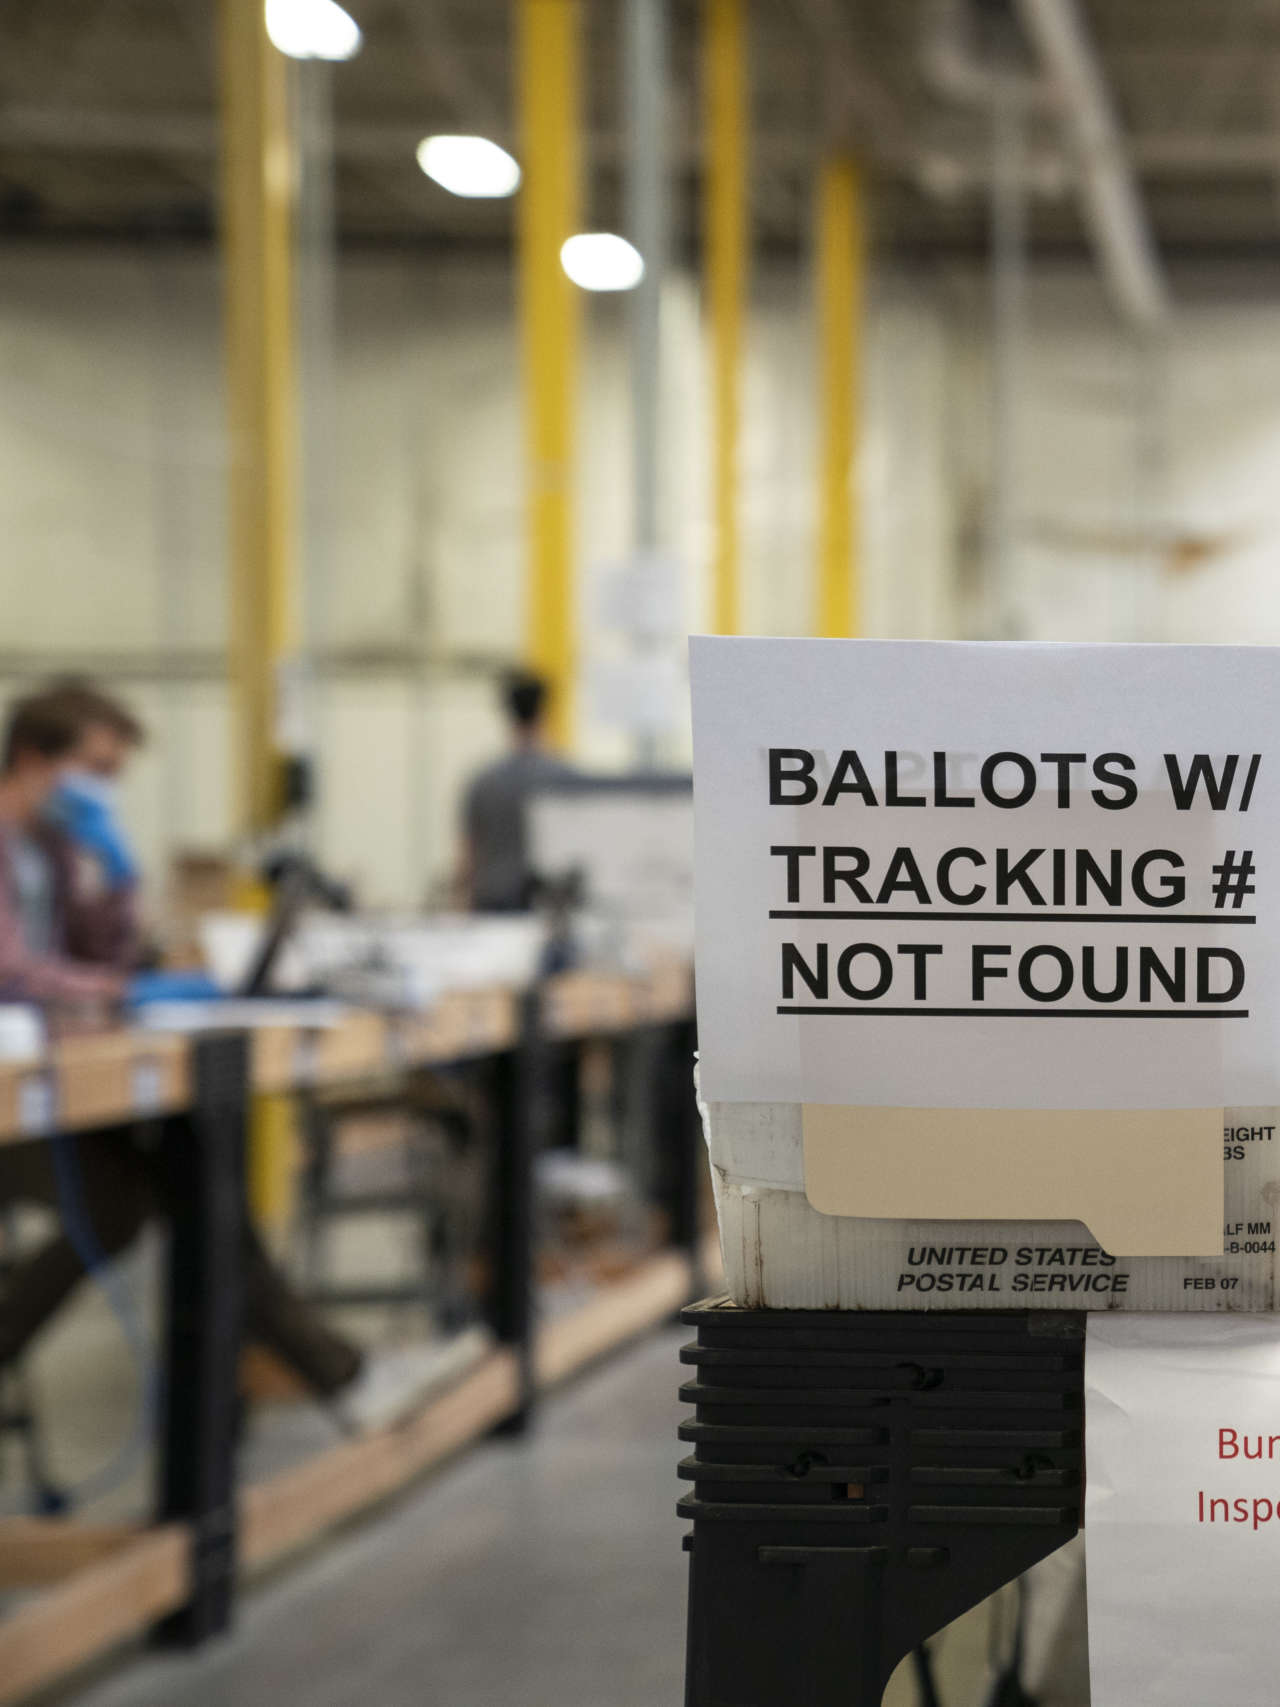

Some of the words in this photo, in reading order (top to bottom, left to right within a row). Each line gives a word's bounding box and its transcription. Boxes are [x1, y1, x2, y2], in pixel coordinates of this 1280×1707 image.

[769, 749, 1137, 810] BALLOTS
[1164, 754, 1261, 811] W/
[771, 846, 1185, 907] TRACKING
[1212, 851, 1255, 908] #
[782, 943, 942, 1000] NOT
[972, 945, 1244, 1002] FOUND
[1224, 1223, 1244, 1236] LF
[1247, 1222, 1271, 1235] MM
[907, 1247, 1008, 1266] UNITED
[1015, 1247, 1117, 1267] STATES
[897, 1273, 1001, 1293] POSTAL
[1011, 1273, 1130, 1293] SERVICE
[1183, 1278, 1216, 1290] FEB
[1220, 1278, 1239, 1290] 07
